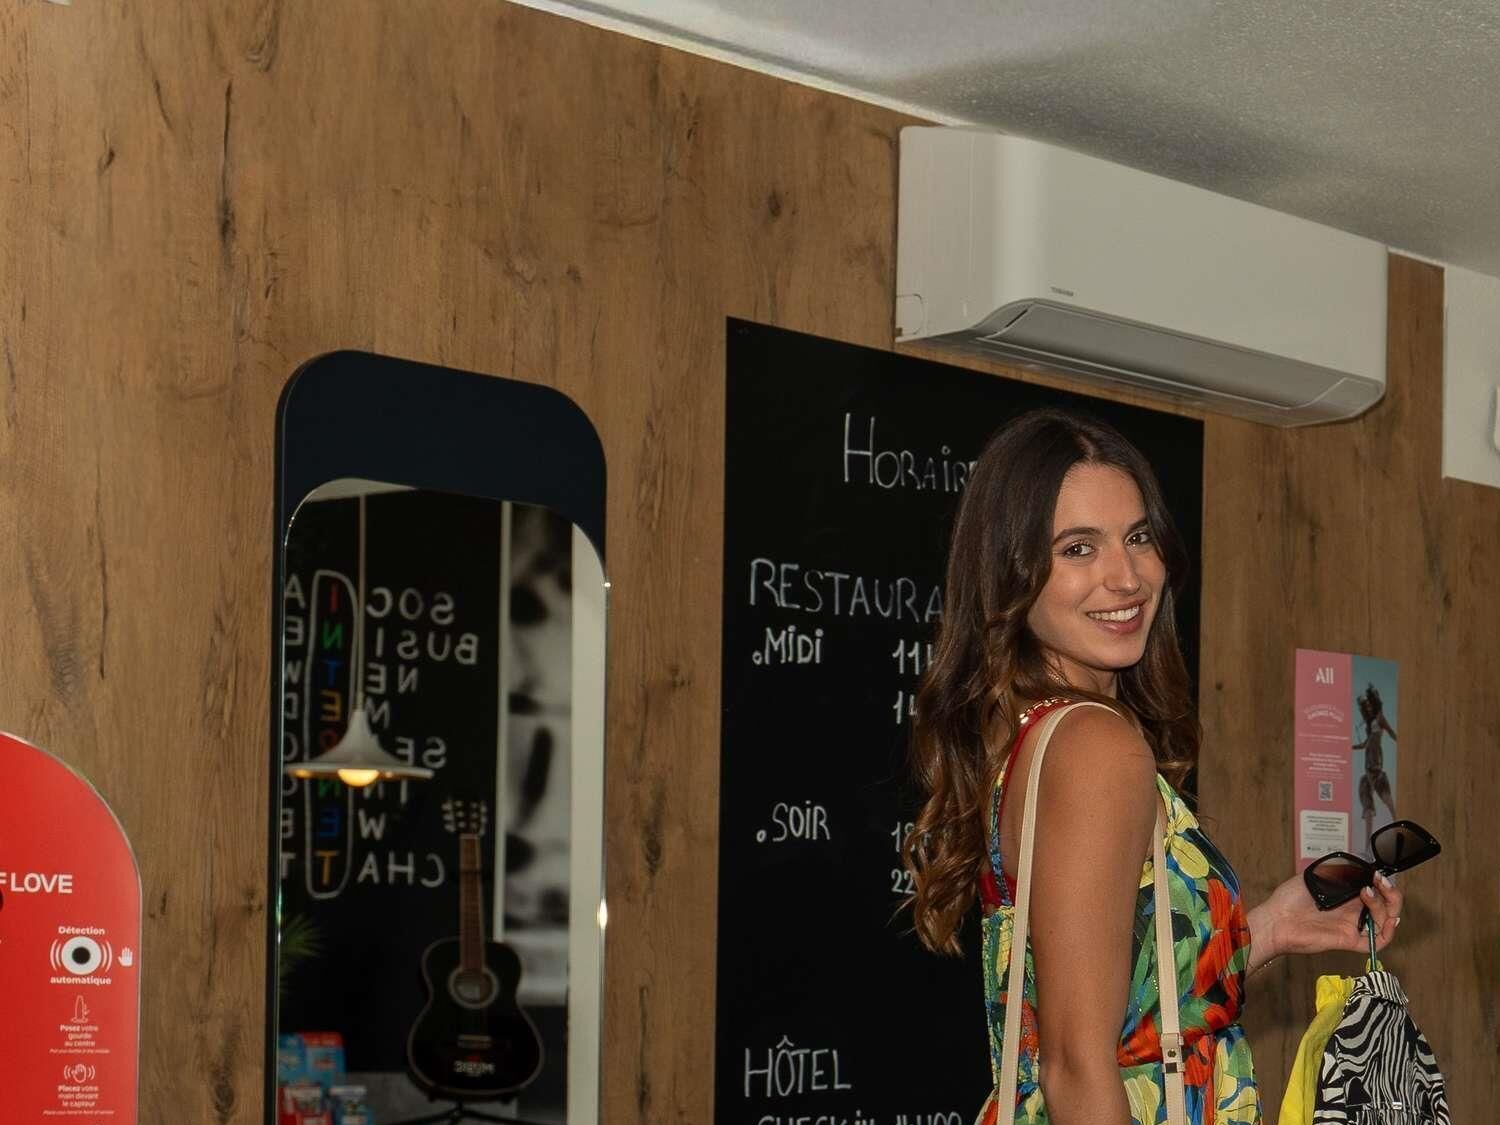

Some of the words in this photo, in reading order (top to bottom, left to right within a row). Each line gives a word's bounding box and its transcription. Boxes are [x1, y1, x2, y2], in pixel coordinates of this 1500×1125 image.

[10, 872, 73, 893] LOVE
[58, 926, 105, 935] Détection
[50, 975, 112, 986] automatique
[743, 1035, 852, 1098] HÔTEL
